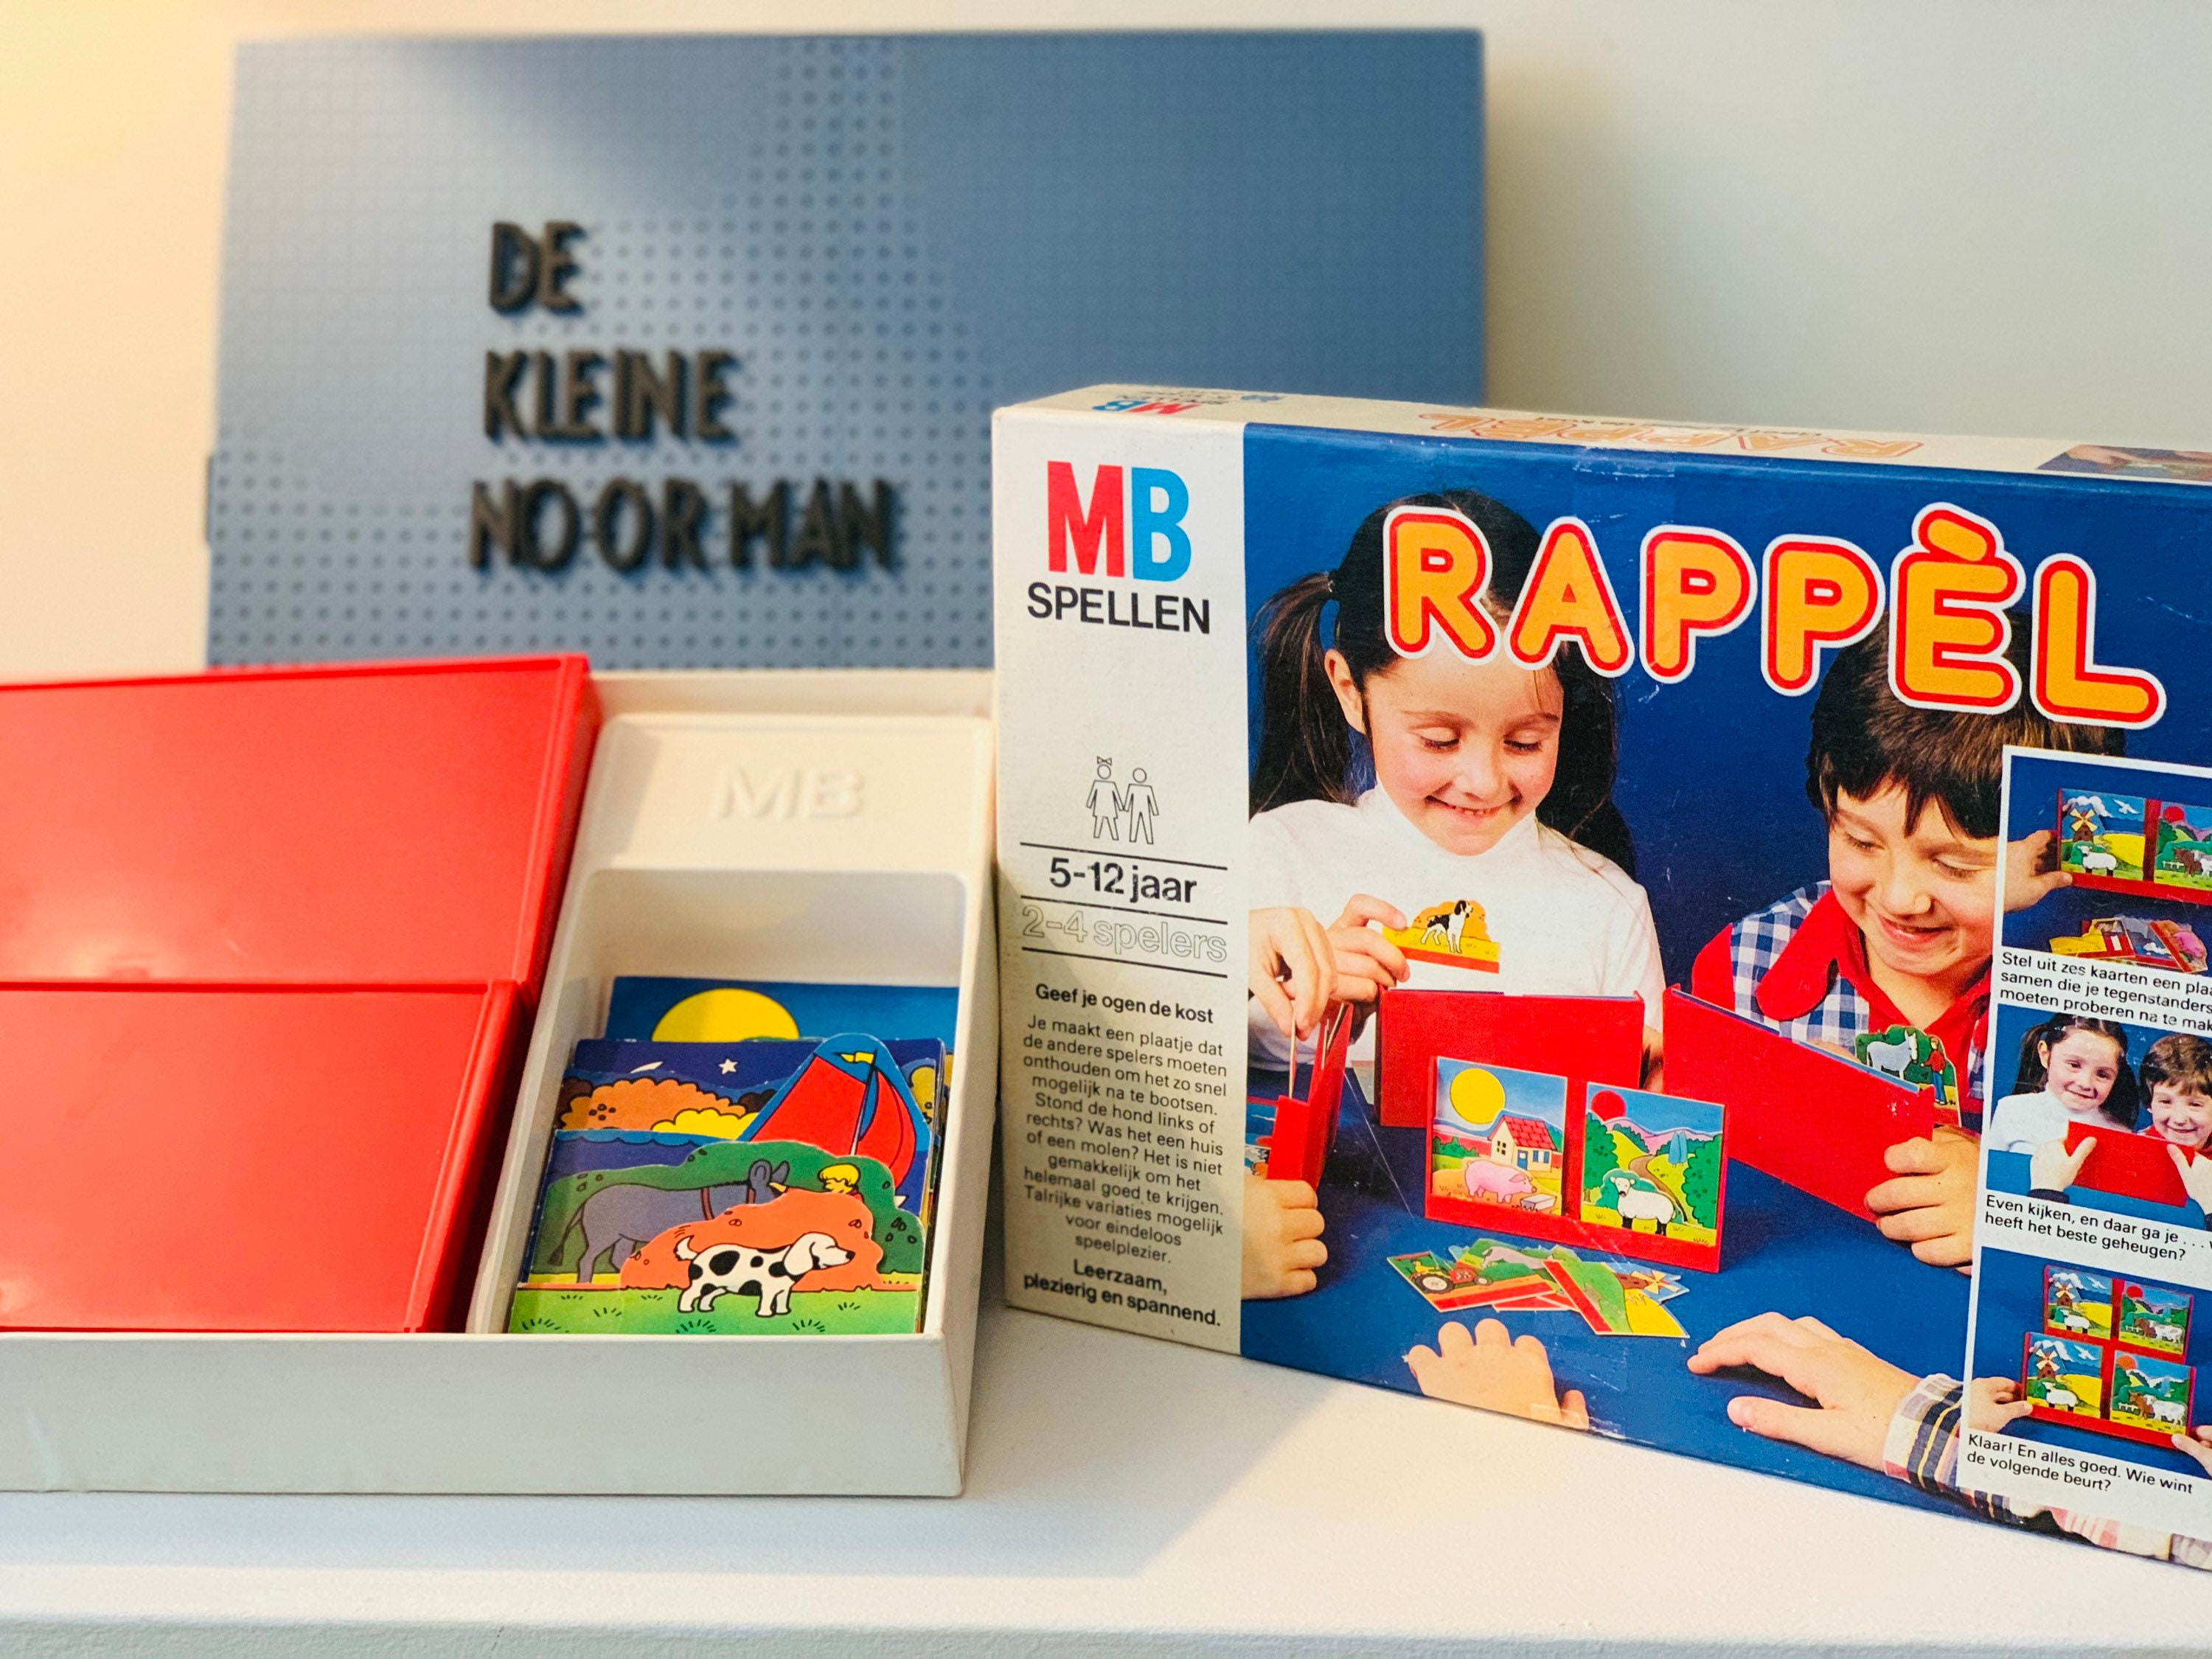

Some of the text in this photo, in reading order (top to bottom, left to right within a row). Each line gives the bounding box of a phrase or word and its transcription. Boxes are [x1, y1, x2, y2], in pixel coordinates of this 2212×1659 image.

[489, 220, 585, 316] DE
[484, 348, 742, 443] KLEINE
[1047, 460, 1192, 582] MB
[1027, 582, 1210, 634] SPELLEN
[1384, 501, 2166, 729] RAPPÈL
[711, 766, 866, 821] MB
[1049, 857, 1197, 903] 5-12 jaar
[1022, 905, 1227, 963] 2-4 spelers
[2001, 970, 2212, 1014] samen die je tegenstanders
[2003, 951, 2031, 967] Stel
[2037, 959, 2056, 972] uit
[2062, 964, 2085, 975] zes
[2091, 965, 2147, 986] kaarten
[2153, 978, 2180, 990] een
[1036, 983, 1213, 1023] Geef je ogen de kost
[2000, 988, 2059, 1006] moeten
[2064, 998, 2134, 1019] proberen
[2140, 1012, 2157, 1023] na
[2163, 1014, 2177, 1026] te
[1023, 1034, 1227, 1077] de andere spelers moeten
[1028, 1015, 1222, 1056] Je maakt een plaatje dat
[1023, 1054, 1226, 1096] onthouden om het zo snel
[1032, 1076, 1217, 1116] mogelijk na te bootsen.
[1027, 1111, 1222, 1155] rechts? Was het een huis
[1036, 1092, 1215, 1134] Stond de hond links of
[1027, 1131, 1222, 1175] of een molen? Het is niet
[1048, 1155, 1200, 1191] gemakkelijk om het
[1024, 1166, 1223, 1215] helemaal goed te krijgen.
[1024, 1184, 1223, 1236] Talrijke variaties mogelijk
[1065, 1214, 1182, 1246] voor eindeloos
[1985, 1212, 2185, 1261] heeft het beste geheugen?
[1986, 1194, 2023, 1213] Even
[2028, 1202, 2075, 1225] kijken,
[2080, 1215, 2098, 1227] en
[2104, 1218, 2136, 1234] daar
[2141, 1227, 2160, 1239] ga
[2165, 1228, 2179, 1243] je
[1075, 1234, 1172, 1263] speelplezier.
[1074, 1259, 1166, 1295] Leerzaam,
[1023, 1273, 1220, 1326] plezierig en spannend.
[1967, 1451, 2111, 1492] de volgende beurt?
[1968, 1433, 2193, 1495] Klaar! En alles goed. Wie wint
